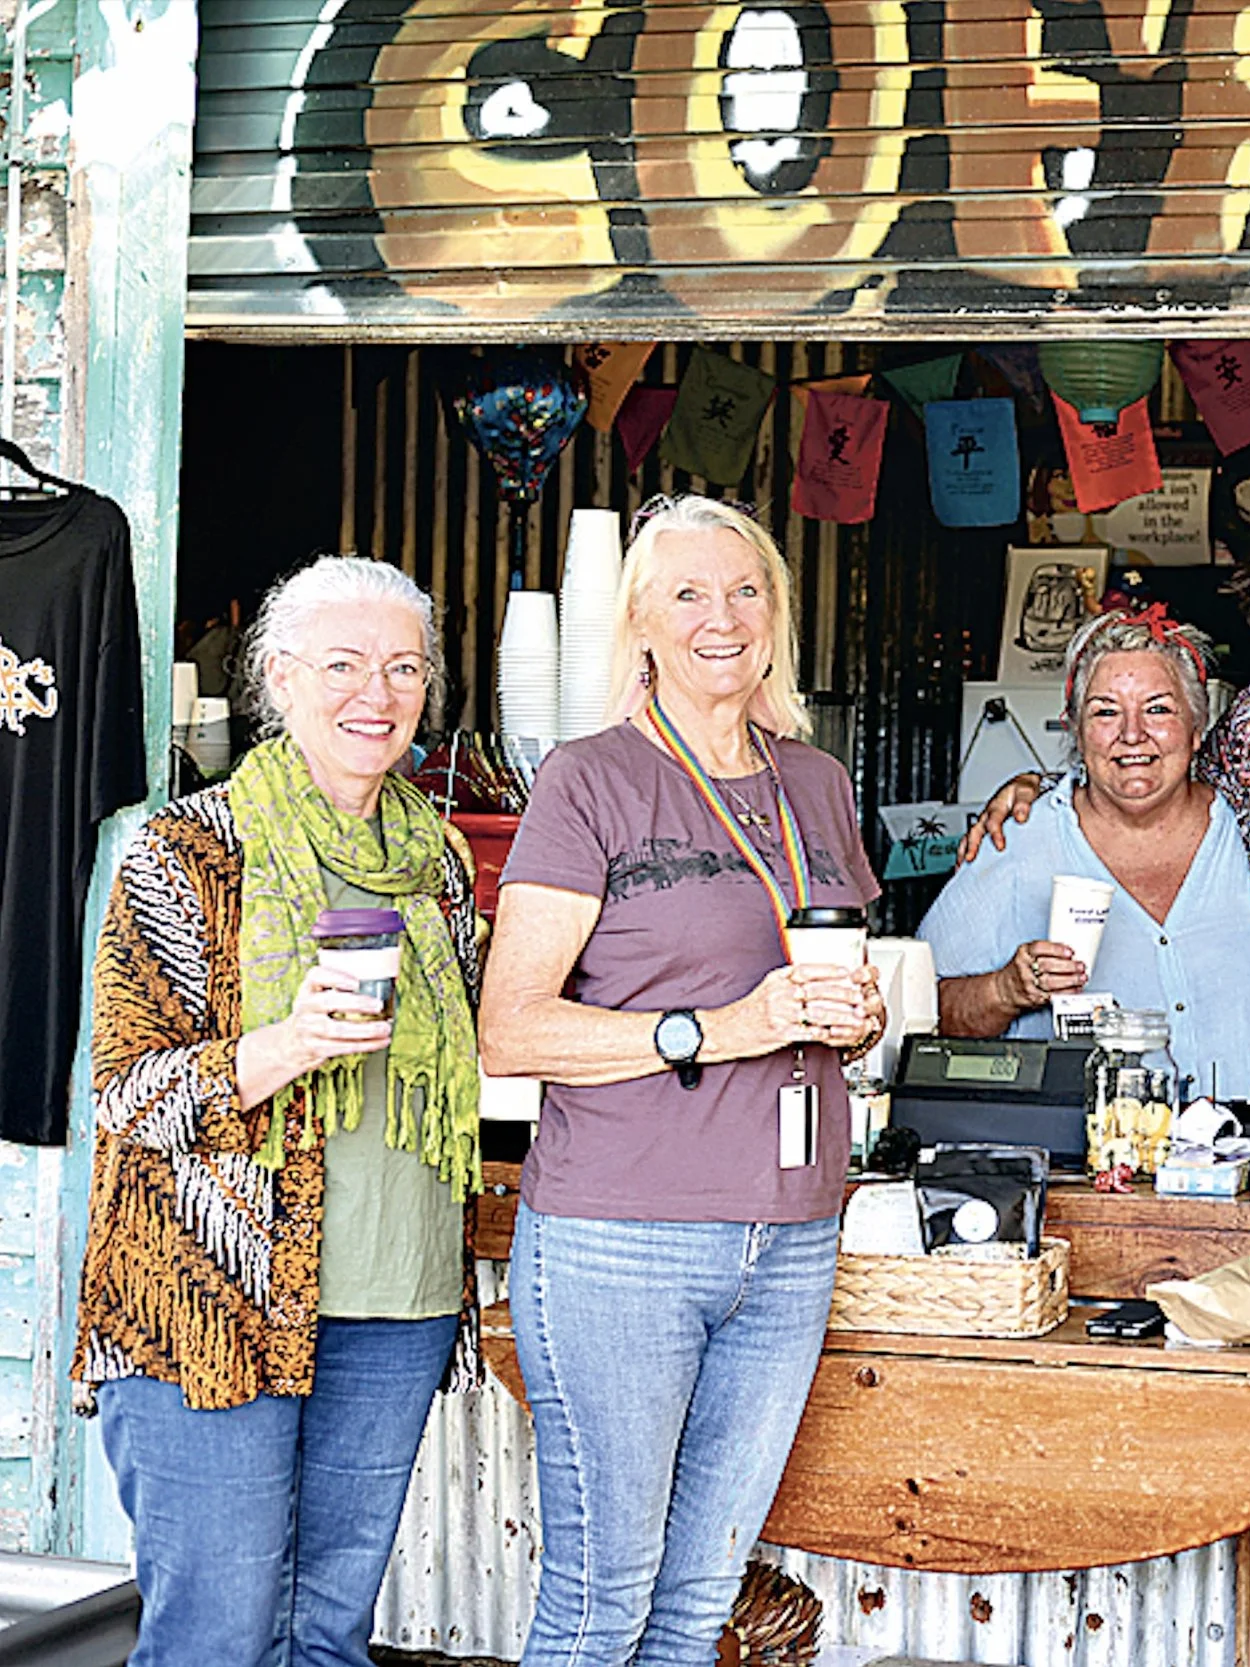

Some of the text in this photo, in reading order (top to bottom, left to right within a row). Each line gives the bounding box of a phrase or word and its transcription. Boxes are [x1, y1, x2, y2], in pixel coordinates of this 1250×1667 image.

[1137, 498, 1190, 512] allowed
[1143, 515, 1184, 528] in the
